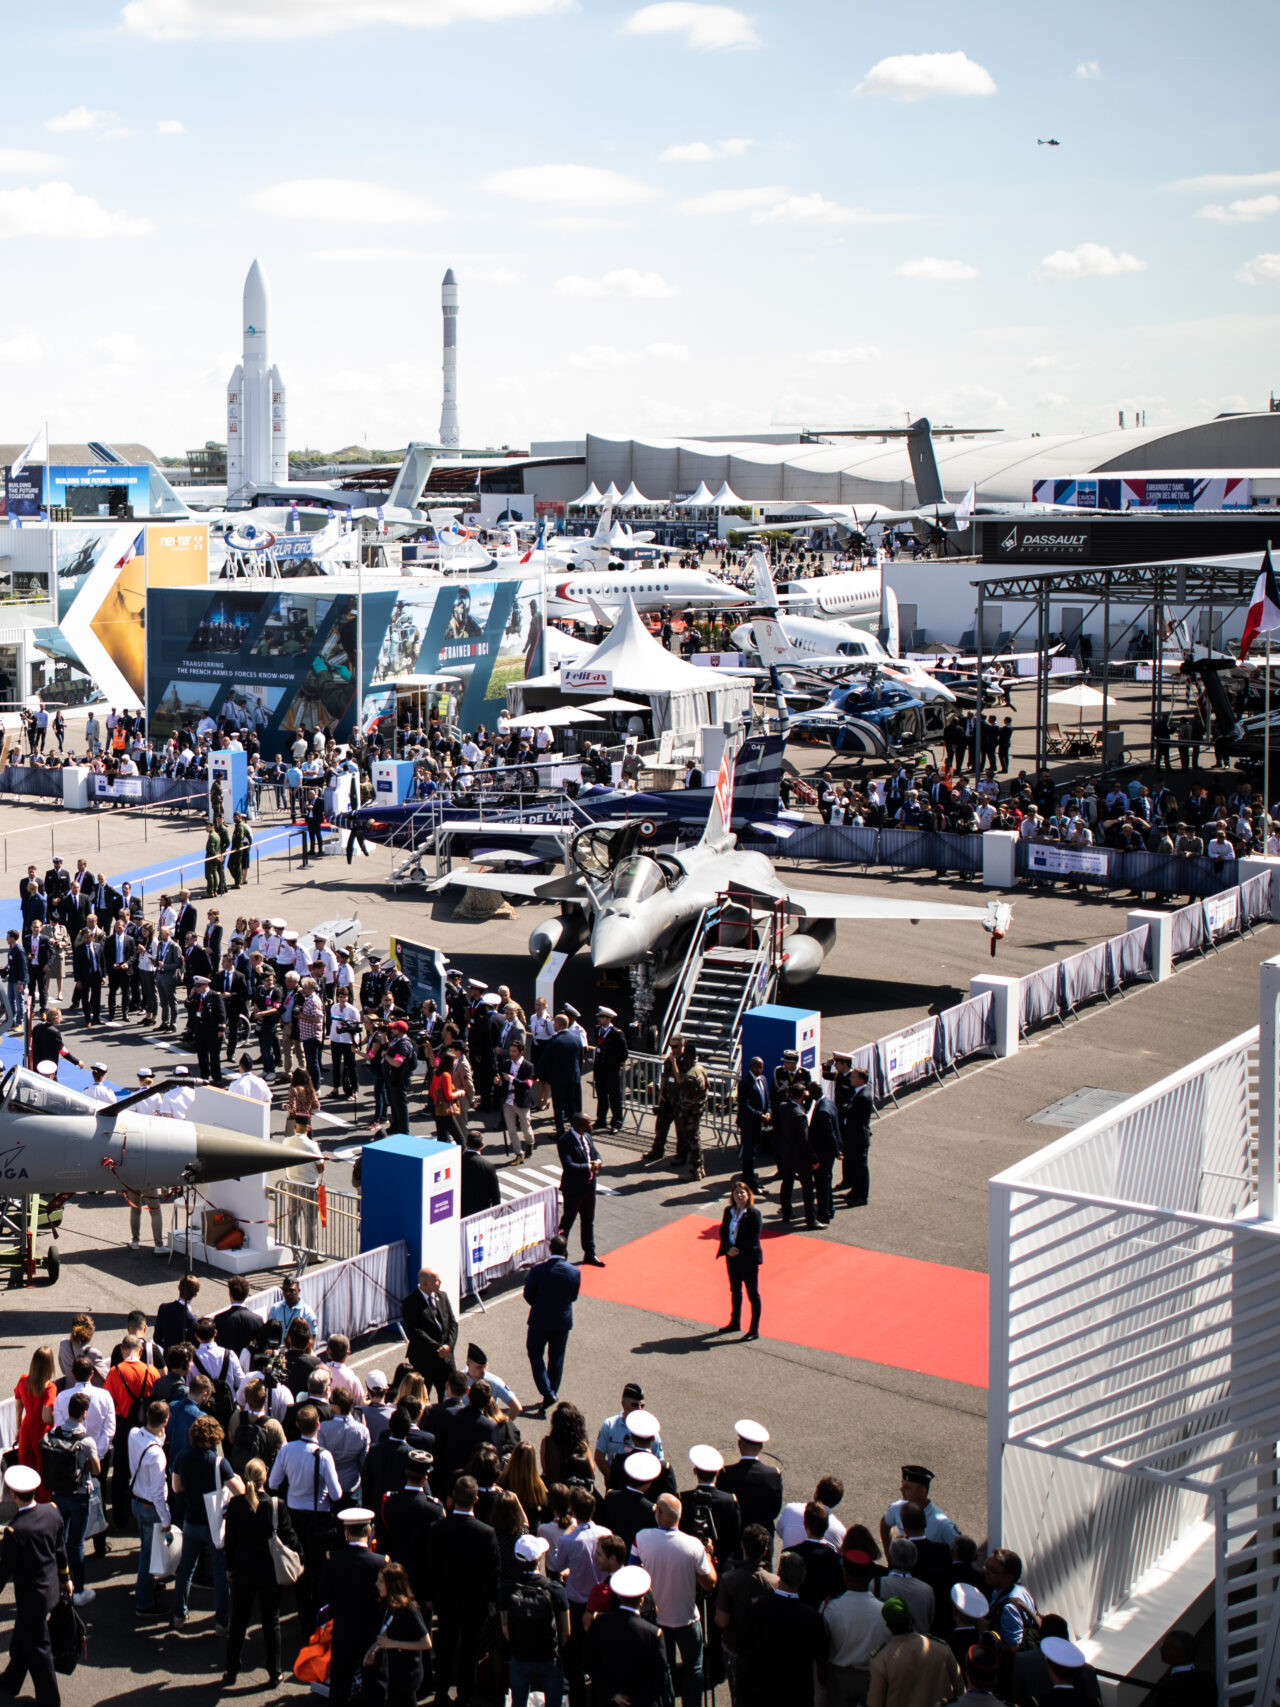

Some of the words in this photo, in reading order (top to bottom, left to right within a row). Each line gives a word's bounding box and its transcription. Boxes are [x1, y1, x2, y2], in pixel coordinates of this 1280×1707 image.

[1022, 535, 1087, 544] DASSAULT
[182, 660, 224, 668] TRANSFERRING
[234, 670, 257, 678] FORCES
[258, 672, 294, 680] KNOW-HOW
[529, 814, 544, 824] DE
[546, 810, 574, 822] L'AIR
